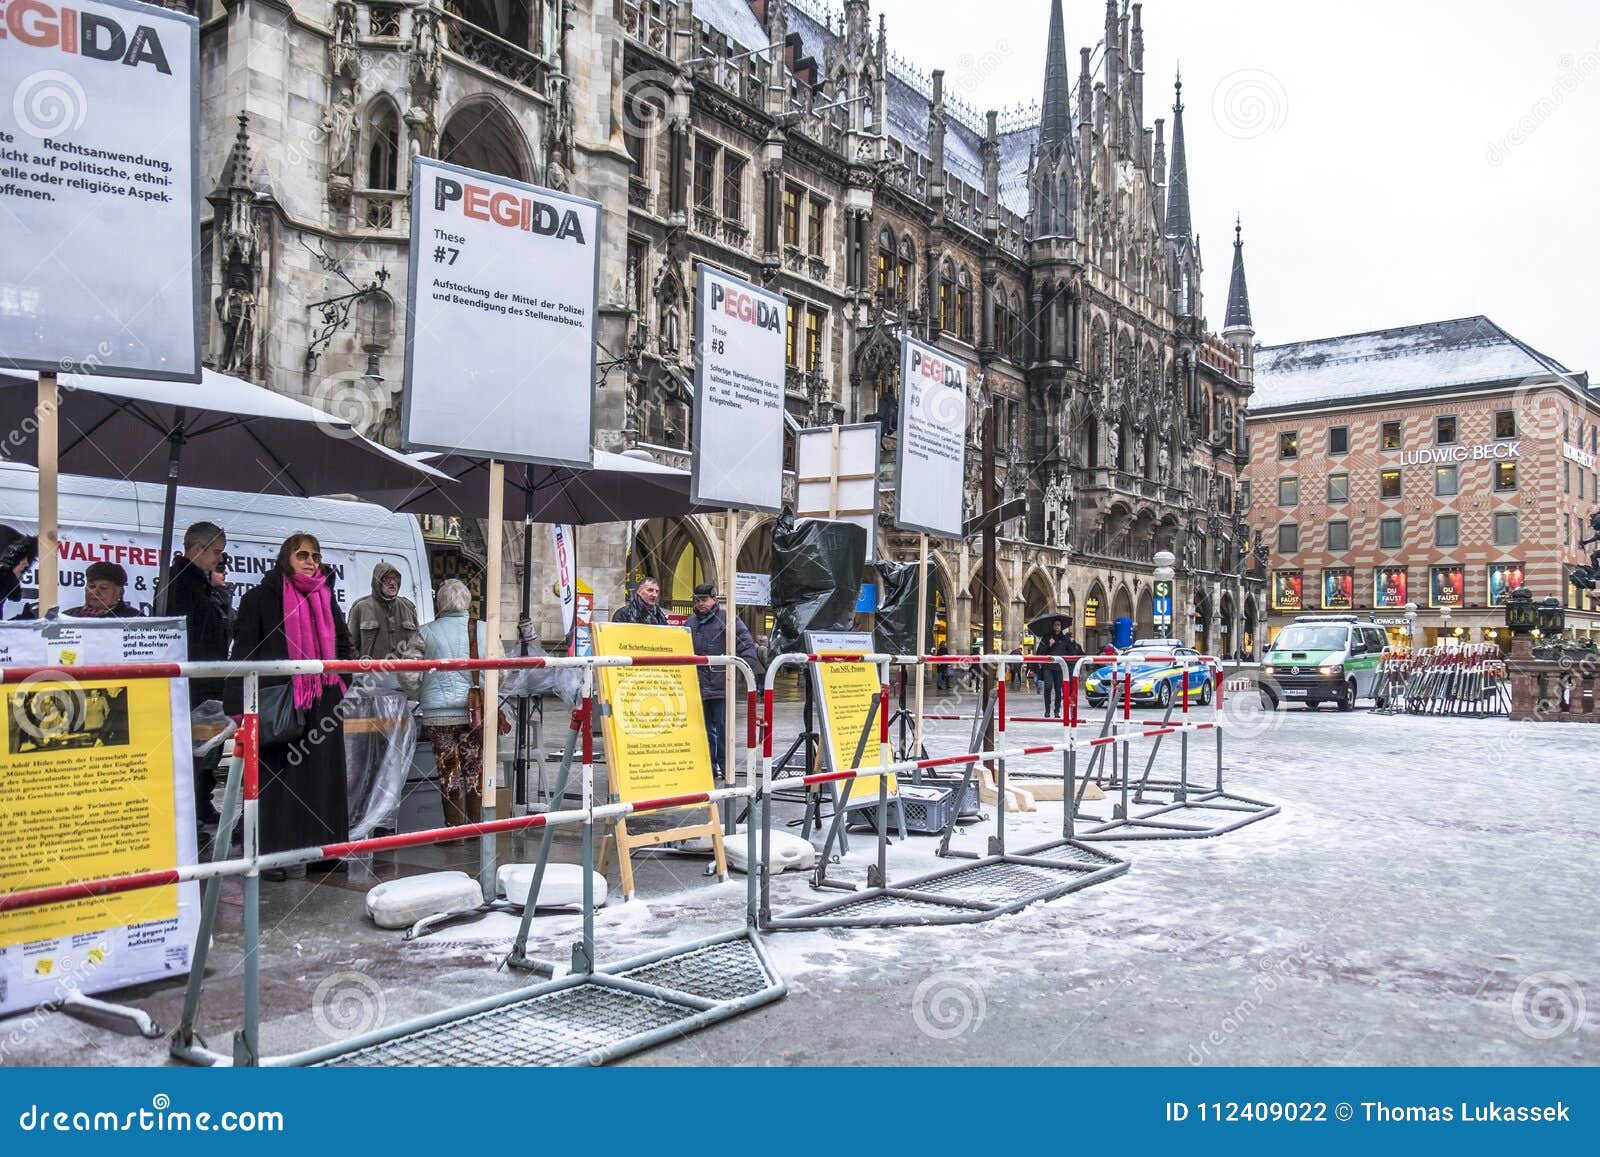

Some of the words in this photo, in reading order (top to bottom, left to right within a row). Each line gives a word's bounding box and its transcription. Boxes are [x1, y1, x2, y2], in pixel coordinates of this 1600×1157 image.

[0, 0, 172, 76] GIDA
[0, 148, 28, 163] icht
[33, 156, 57, 167] auf
[60, 158, 130, 181] politische,
[134, 172, 173, 187] ethni-
[43, 138, 173, 172] Rechtsanwendung,
[0, 167, 28, 180] elle
[31, 172, 64, 186] oder
[66, 178, 126, 196] religiöse
[129, 186, 173, 203] Aspek-
[434, 176, 586, 245] PEGIDA
[434, 229, 466, 245] These
[433, 246, 460, 266] #7
[432, 293, 451, 303] und
[452, 295, 507, 315] Beendigung
[508, 305, 524, 316] des
[524, 309, 585, 328] Stellenabbaus.
[433, 278, 490, 299] Aufstockung
[494, 290, 508, 301] der
[512, 294, 538, 307] Mittel
[540, 299, 555, 310] der
[558, 303, 585, 316] Polizei
[711, 282, 781, 334] PEGIDA
[711, 338, 724, 355] #8
[712, 325, 727, 337] These
[911, 349, 963, 392] PEGIDA
[1400, 448, 1468, 466] LUDWIG
[1473, 441, 1521, 460] BECK
[1156, 582, 1168, 596] S
[1437, 594, 1459, 602] FAUST
[1156, 600, 1168, 614] U
